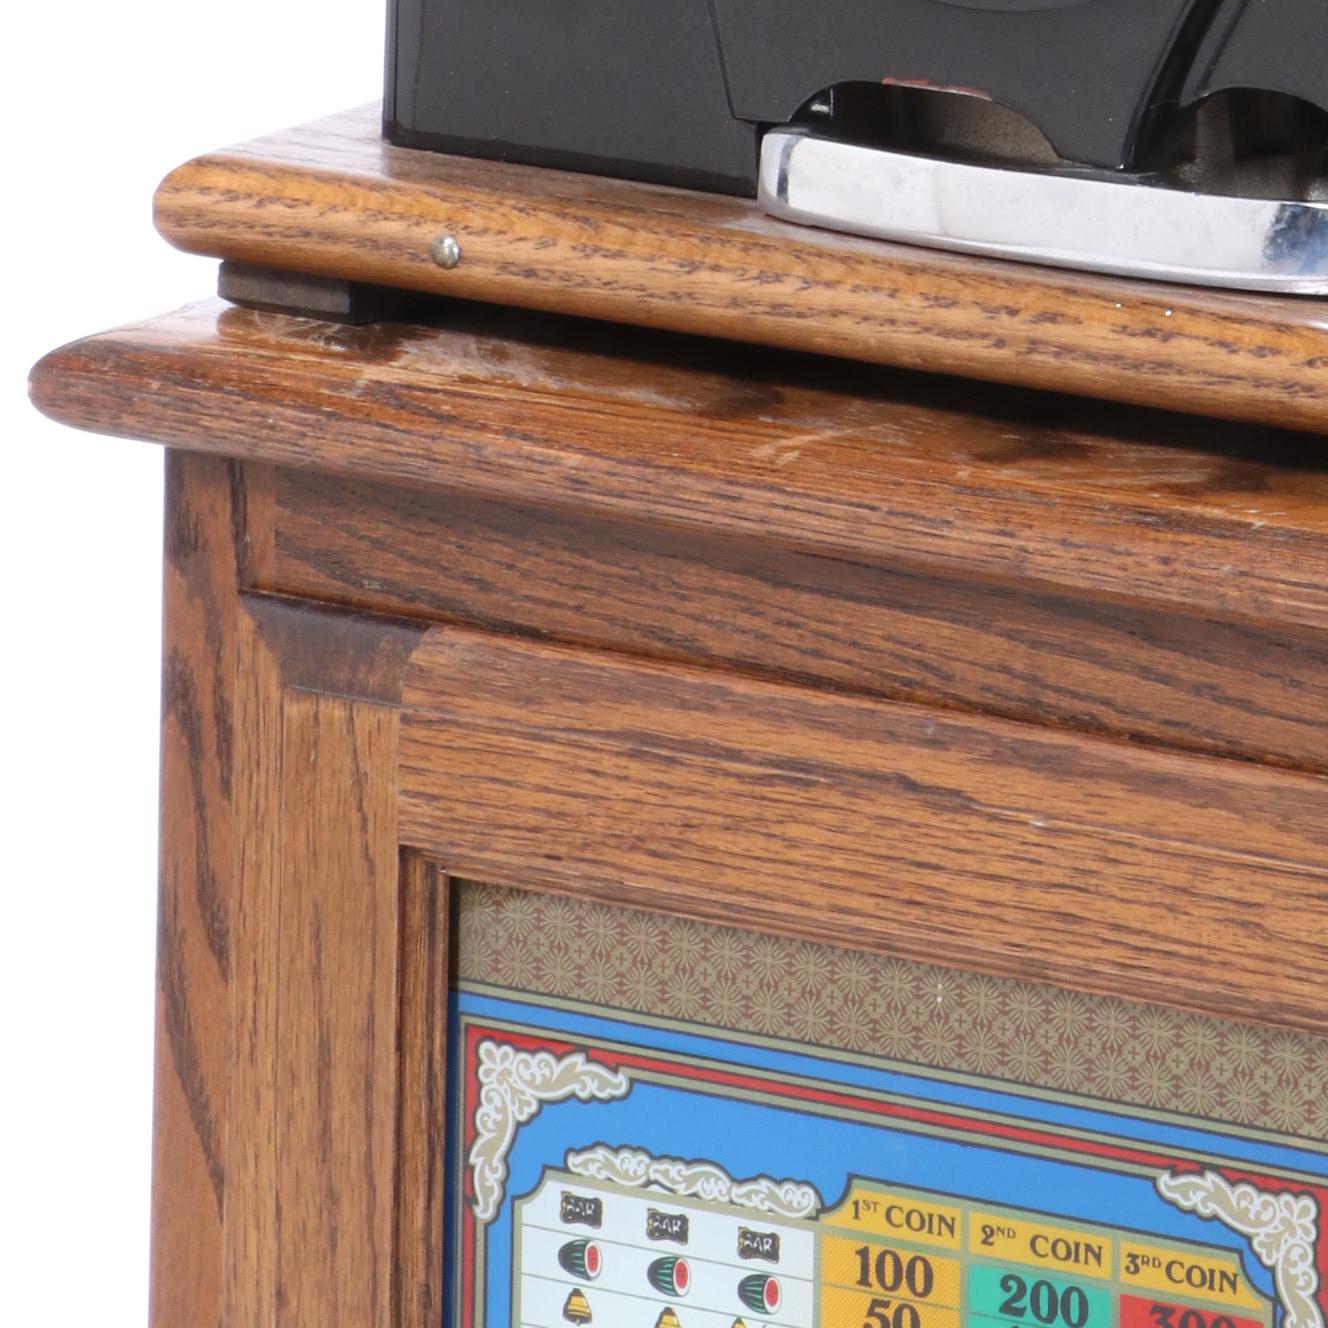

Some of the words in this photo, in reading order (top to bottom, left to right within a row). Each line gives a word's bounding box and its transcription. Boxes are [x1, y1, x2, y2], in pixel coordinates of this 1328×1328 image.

[885, 1205, 956, 1239] COIN
[1029, 1234, 1103, 1268] COIN
[855, 1246, 934, 1299] 100
[1165, 1260, 1239, 1295] COIN
[998, 1273, 1089, 1328] 200
